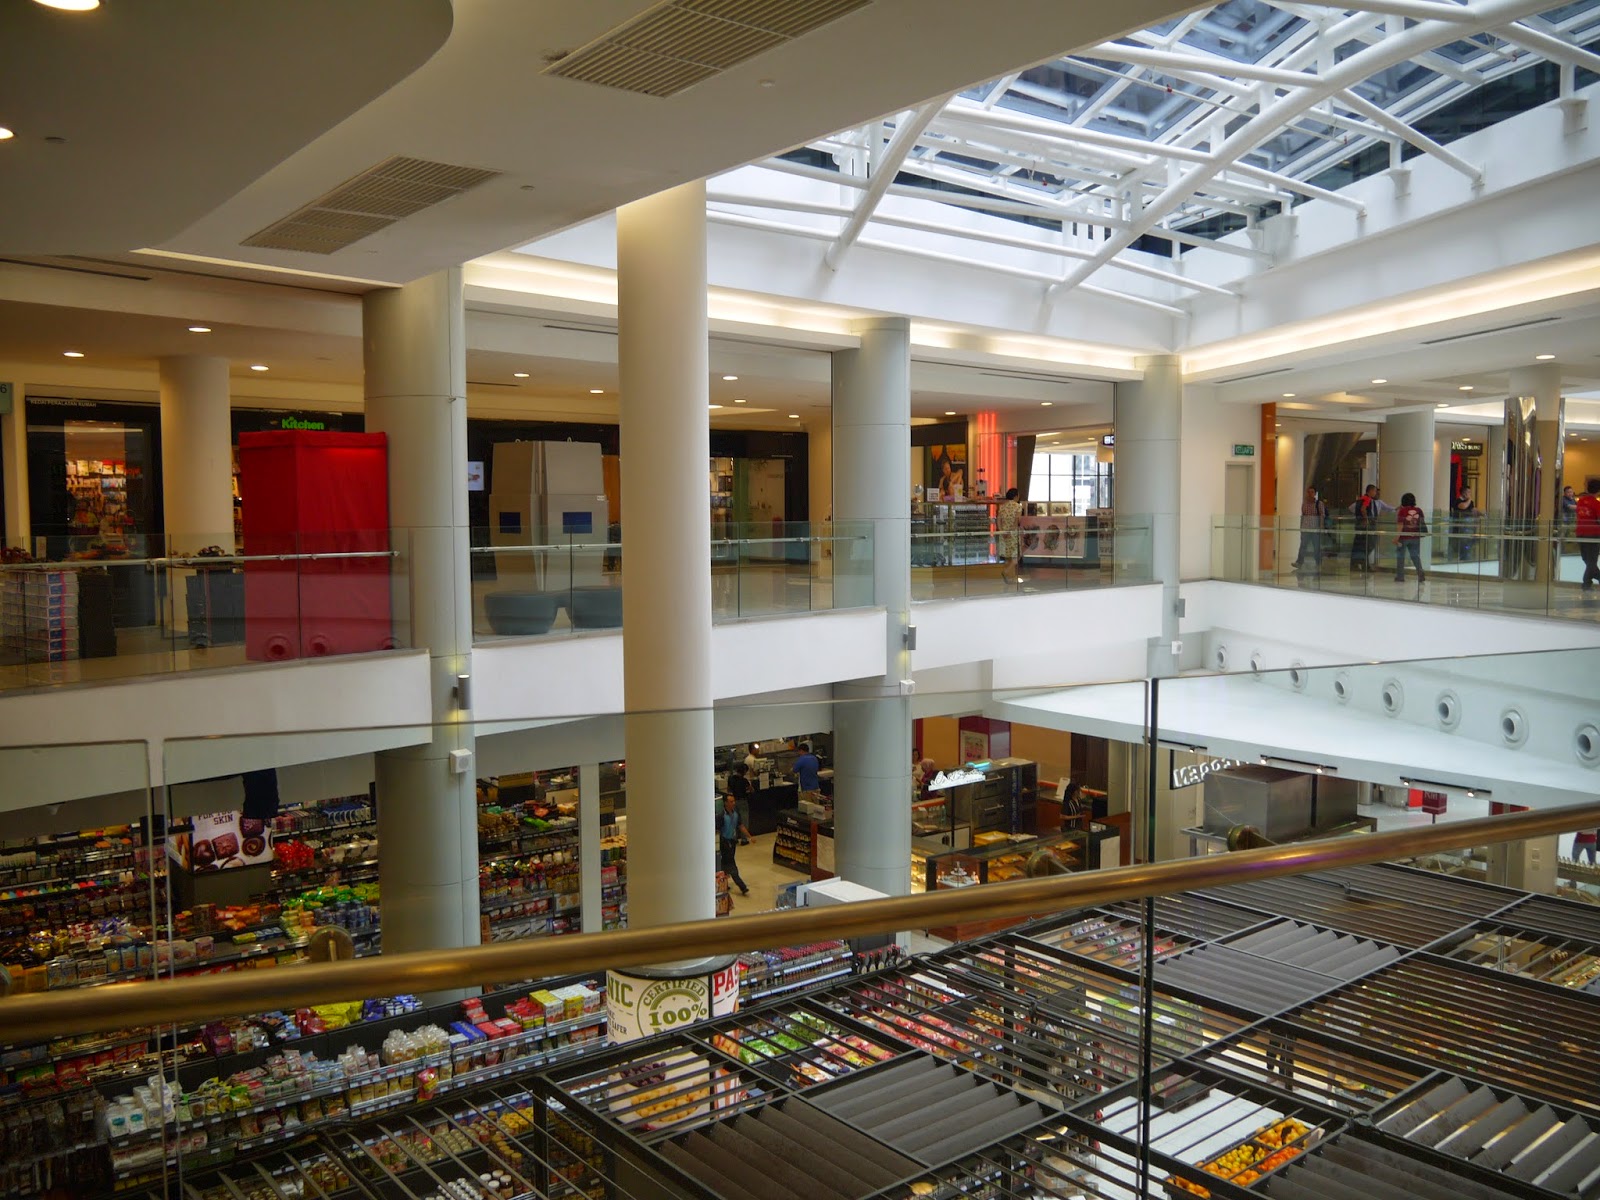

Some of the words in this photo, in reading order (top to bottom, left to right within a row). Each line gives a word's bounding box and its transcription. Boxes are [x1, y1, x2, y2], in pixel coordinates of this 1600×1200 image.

[281, 416, 325, 430] Kitchen
[213, 814, 233, 825] SKIN
[643, 979, 706, 1007] CERTIFIED
[649, 1001, 708, 1027] 100%
